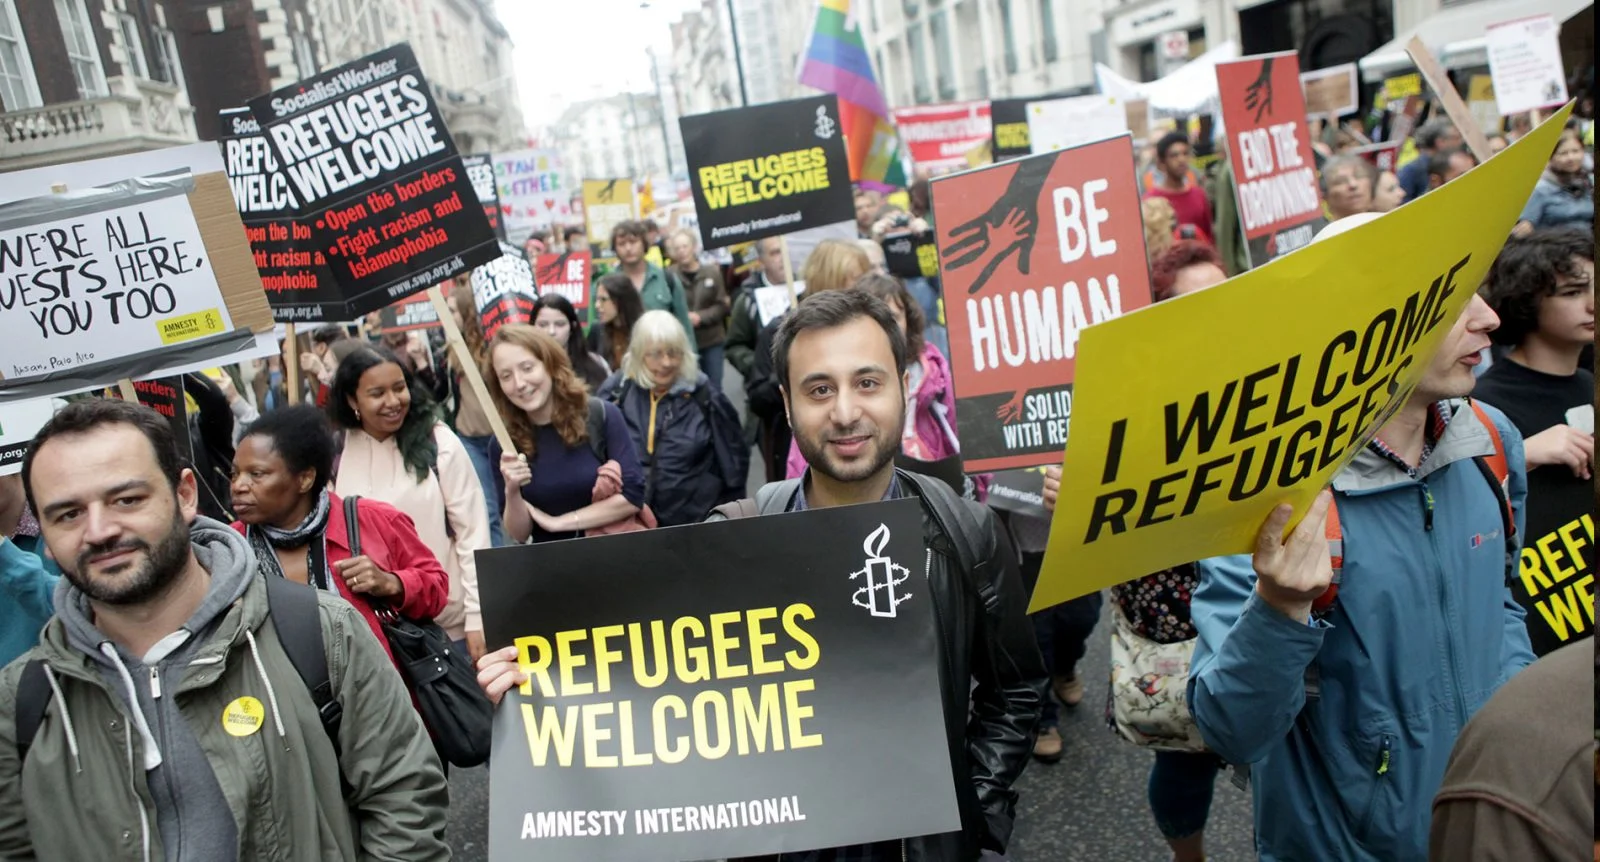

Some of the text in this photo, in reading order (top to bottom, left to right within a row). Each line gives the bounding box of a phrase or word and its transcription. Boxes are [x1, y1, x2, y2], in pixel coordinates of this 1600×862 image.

[270, 74, 428, 166] REFUGEES
[287, 112, 446, 204] WELCOME
[698, 146, 827, 189] REFUGEES
[1238, 121, 1304, 180] END THE
[324, 200, 368, 231] Open
[368, 188, 396, 216] the
[396, 167, 457, 201] borders
[703, 167, 830, 210] WELCOME
[105, 211, 167, 252] ALL
[243, 225, 267, 243] pen
[269, 222, 289, 241] the
[337, 231, 380, 258] Fight
[381, 209, 433, 241] racism
[434, 191, 463, 220] and
[711, 210, 802, 238] Amnesty International
[1052, 178, 1117, 263] BE
[270, 248, 311, 268] racism
[348, 228, 449, 280] Islamophobia
[387, 255, 465, 297] www.swp.org.uk
[568, 259, 585, 281] BE
[0, 259, 107, 312] UESTS
[30, 282, 177, 339] YOU TOO
[163, 317, 198, 333] AMNESTY
[49, 356, 73, 369] Palo
[75, 351, 95, 364] Alto
[1100, 252, 1472, 486] I WELCOME
[1003, 422, 1043, 449] WITH
[1082, 354, 1414, 546] REFUGEES
[514, 603, 821, 698] REFUGEES
[519, 679, 823, 768] WELCOME
[520, 795, 806, 840] AMNESTY INTERNATIONAL
